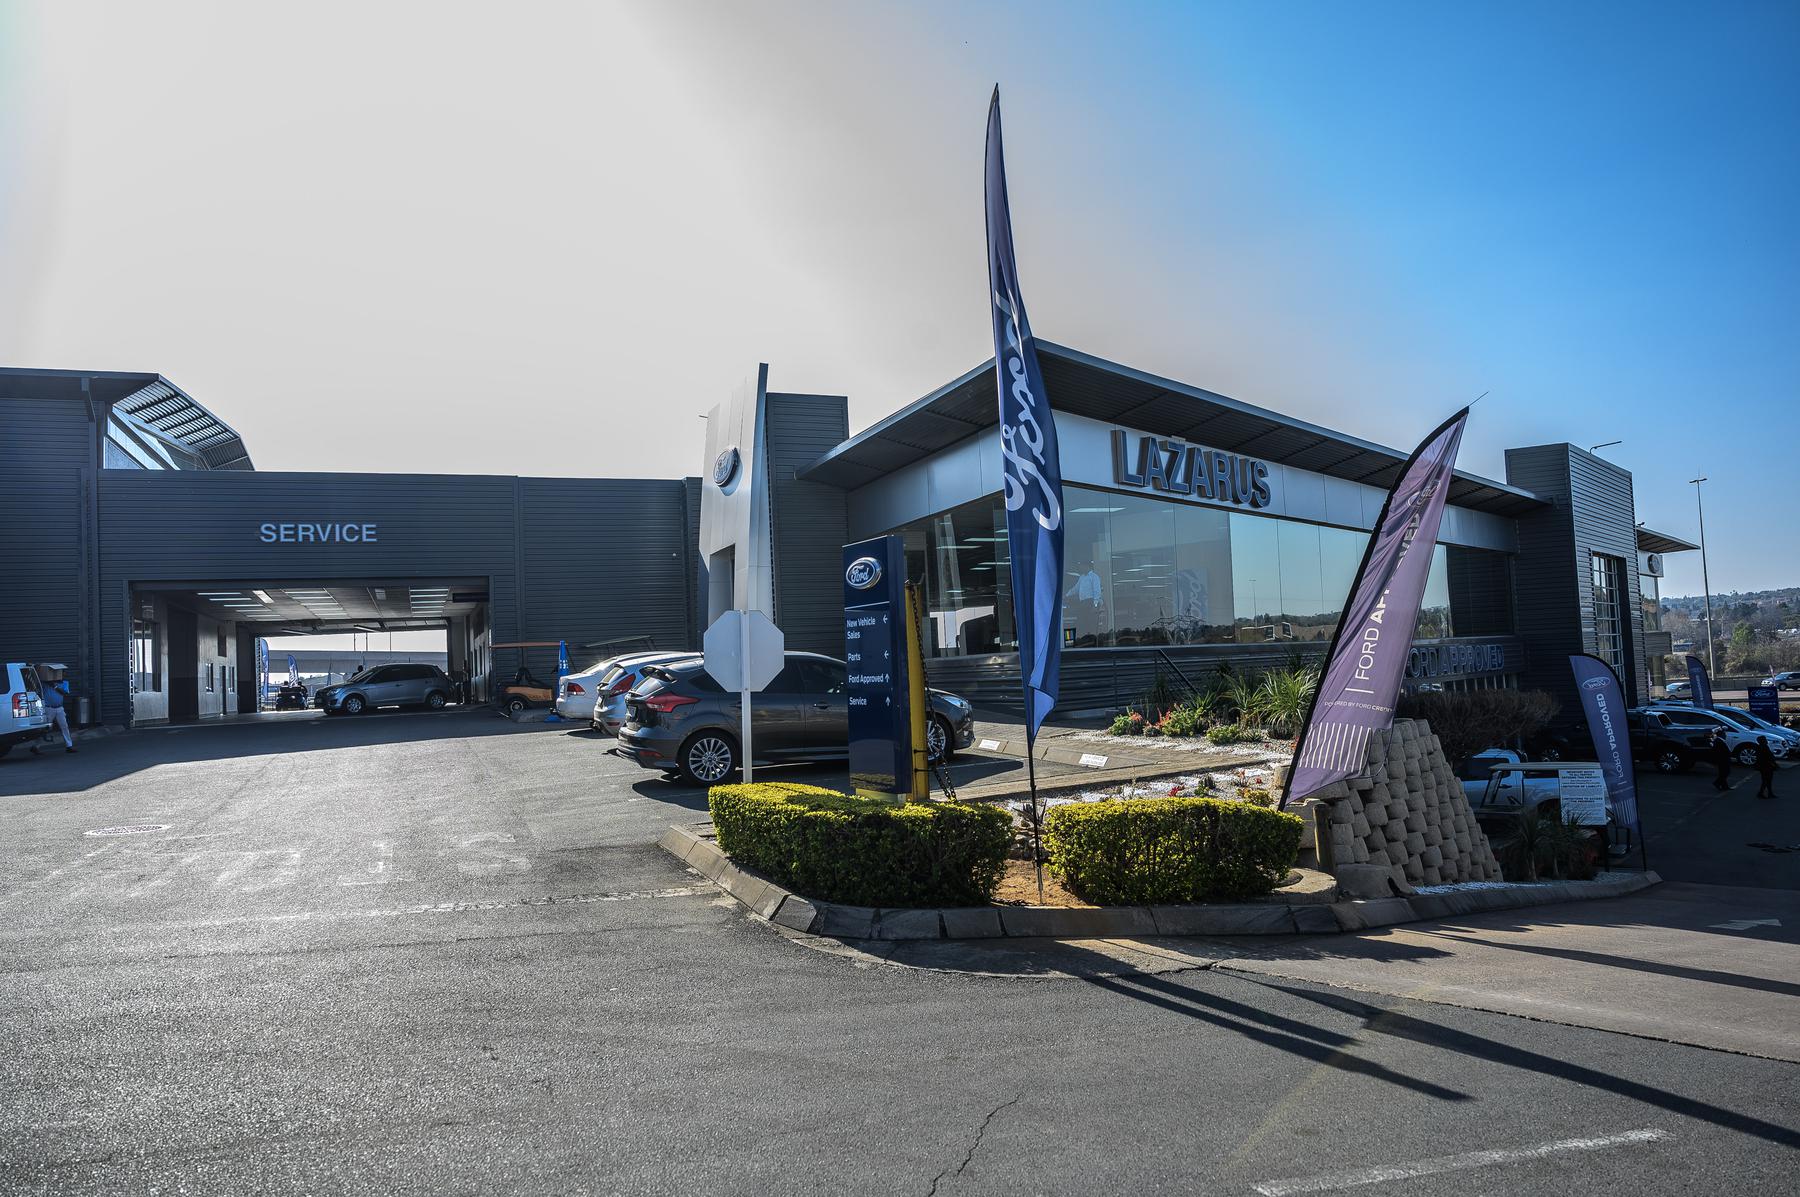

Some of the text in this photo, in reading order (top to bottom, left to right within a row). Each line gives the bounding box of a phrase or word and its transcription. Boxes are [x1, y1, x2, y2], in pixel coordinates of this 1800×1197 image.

[1111, 430, 1271, 508] LAZARUS
[260, 523, 377, 542] SERVICE
[850, 564, 870, 583] Ford
[847, 616, 876, 628] New Vehicle
[847, 630, 861, 640] Sales
[848, 653, 861, 661] Parts
[1355, 628, 1379, 680] FORD
[1405, 644, 1505, 678] ORD APPROVED
[848, 673, 884, 685] Ford Approved
[849, 696, 867, 705] Service
